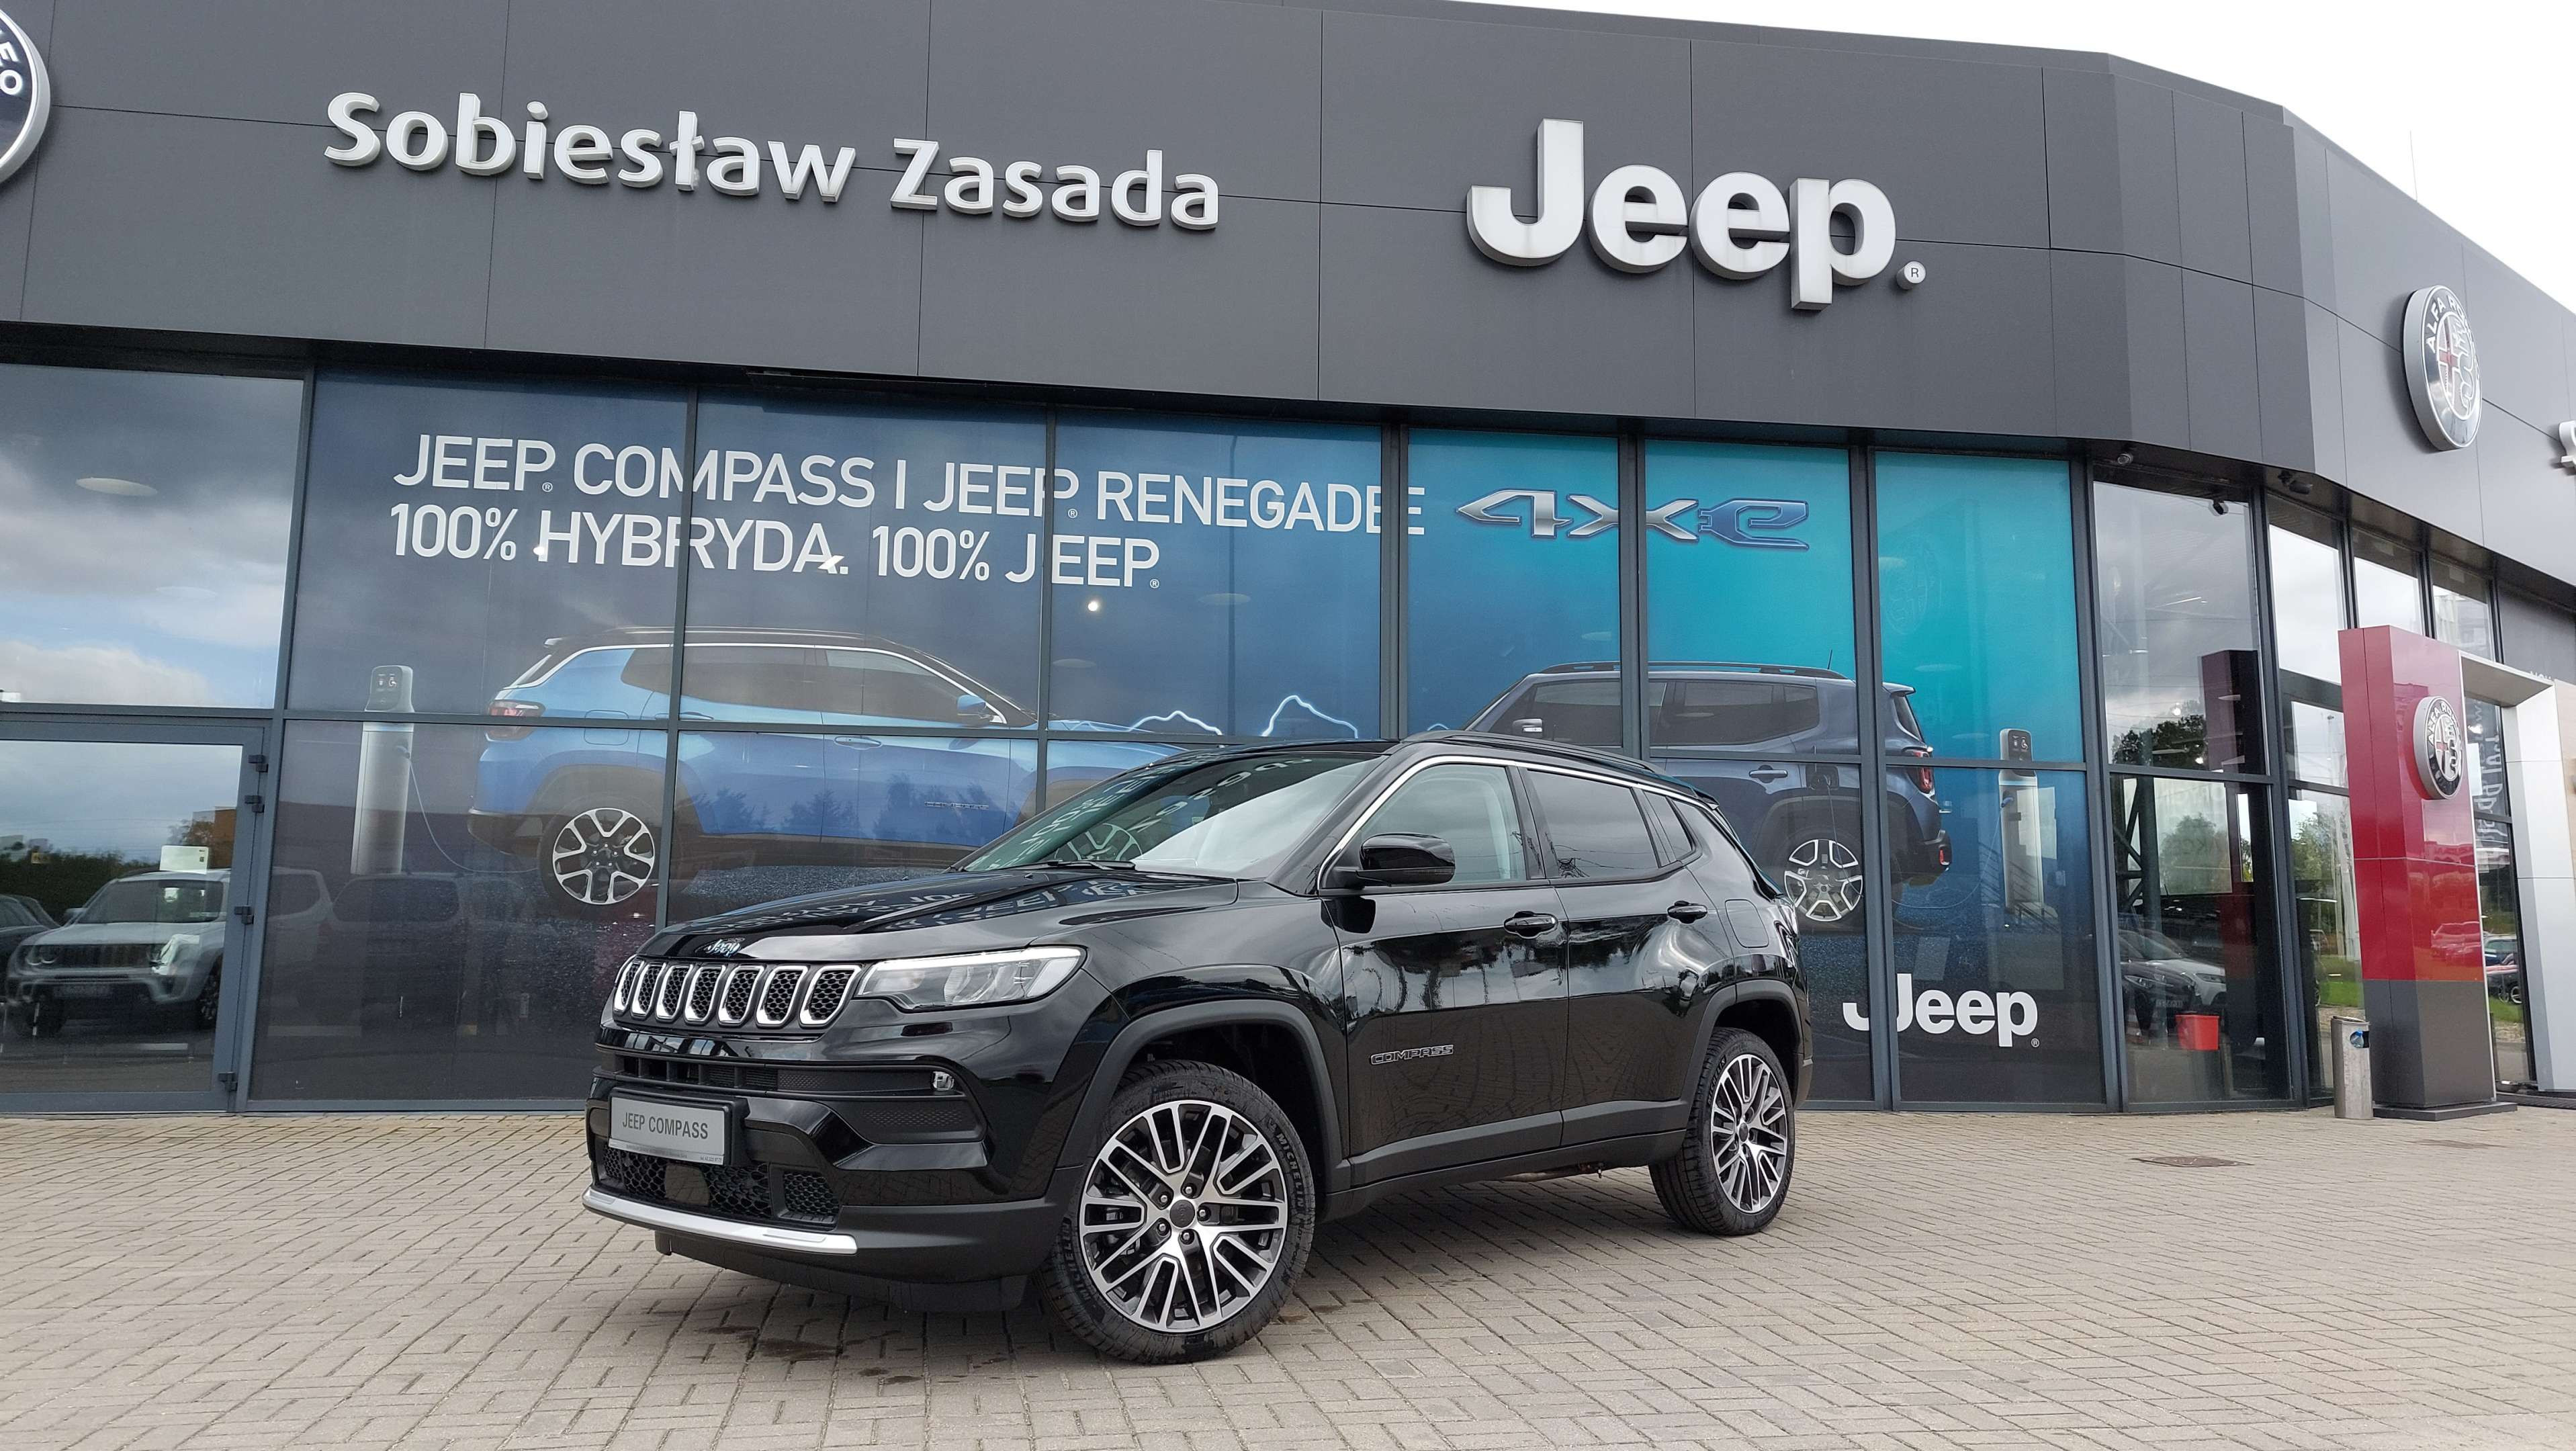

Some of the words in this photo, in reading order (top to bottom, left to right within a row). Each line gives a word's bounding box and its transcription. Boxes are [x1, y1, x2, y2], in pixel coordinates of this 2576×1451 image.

[0, 29, 24, 95] EO
[324, 92, 856, 204] Sobiesław
[890, 138, 1219, 230] Zasada
[2426, 297, 2446, 353] ALFA
[574, 443, 875, 508] COMPASS
[1098, 471, 1425, 535] RENEGADE
[390, 503, 519, 561] 100%
[539, 510, 849, 575] HYBRYDA.
[873, 526, 990, 581] 100%
[2428, 707, 2441, 746] ALFA
[1371, 1045, 1454, 1065] COMPASS
[623, 1112, 645, 1131] JEEP
[649, 1116, 708, 1139] COMPASS
[1276, 1133, 1304, 1208] MICHELIN
